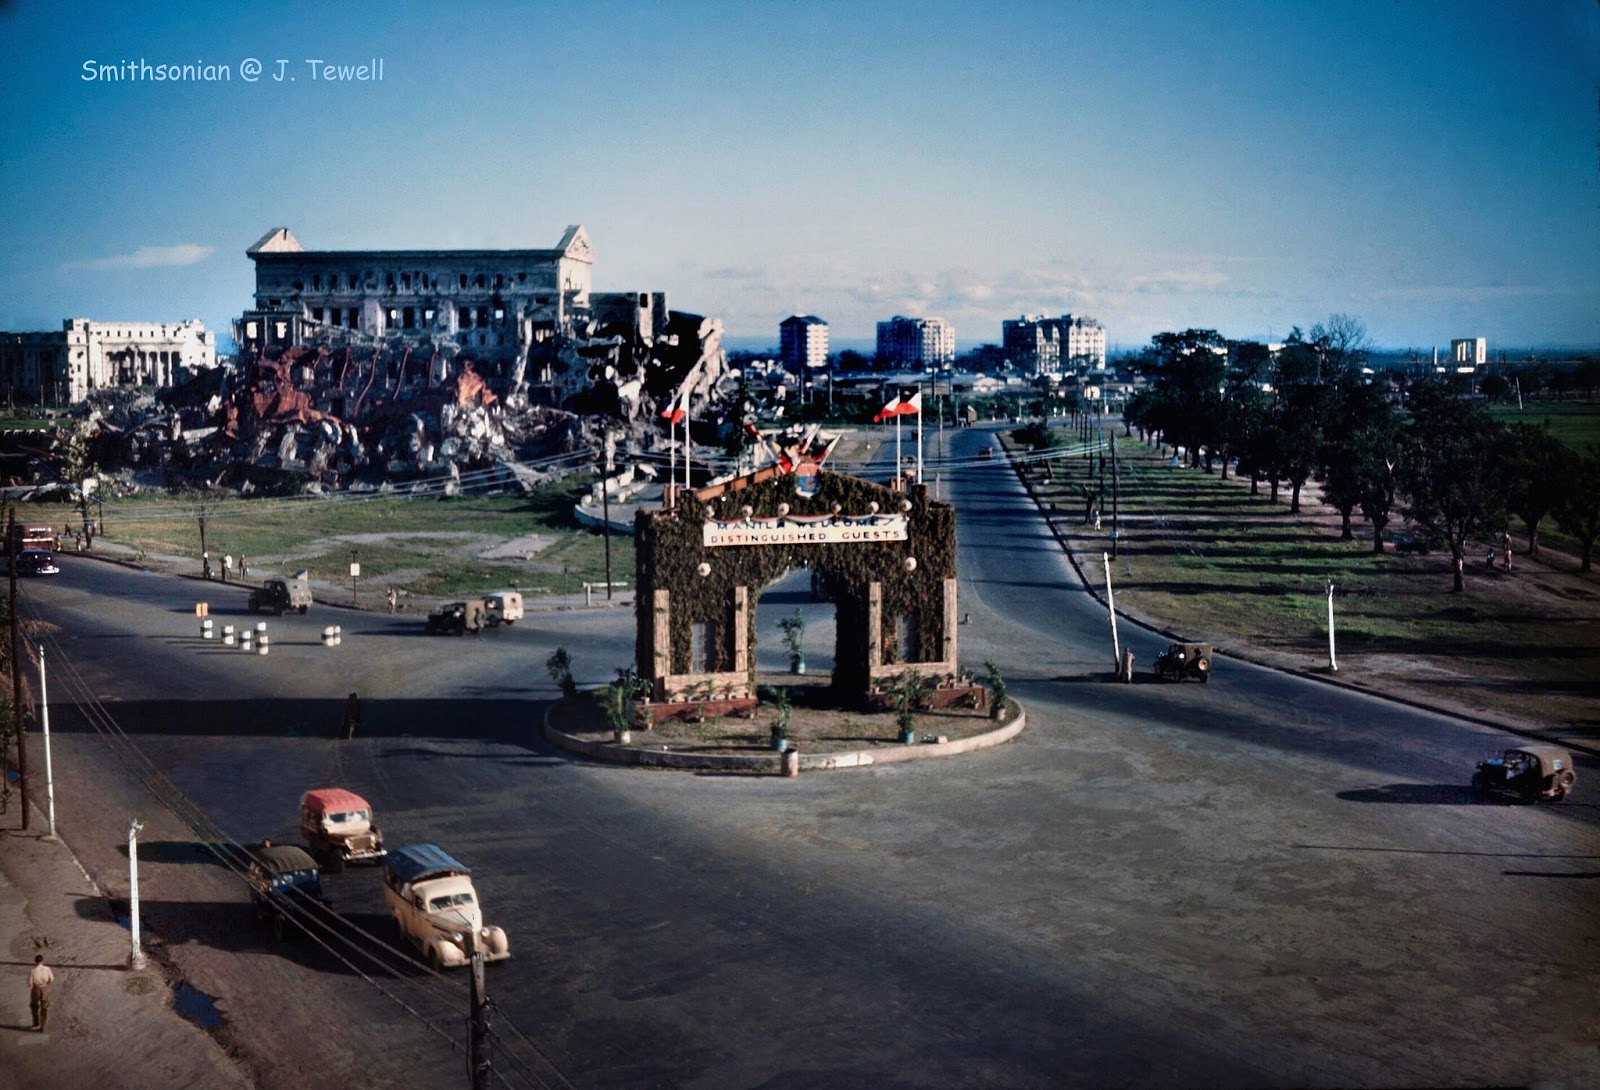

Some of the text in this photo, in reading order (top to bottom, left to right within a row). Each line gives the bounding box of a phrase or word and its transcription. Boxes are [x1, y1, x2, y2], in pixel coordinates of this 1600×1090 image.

[717, 518, 786, 529] MANILA
[711, 530, 900, 543] DISTINGUISHED GUESTS
